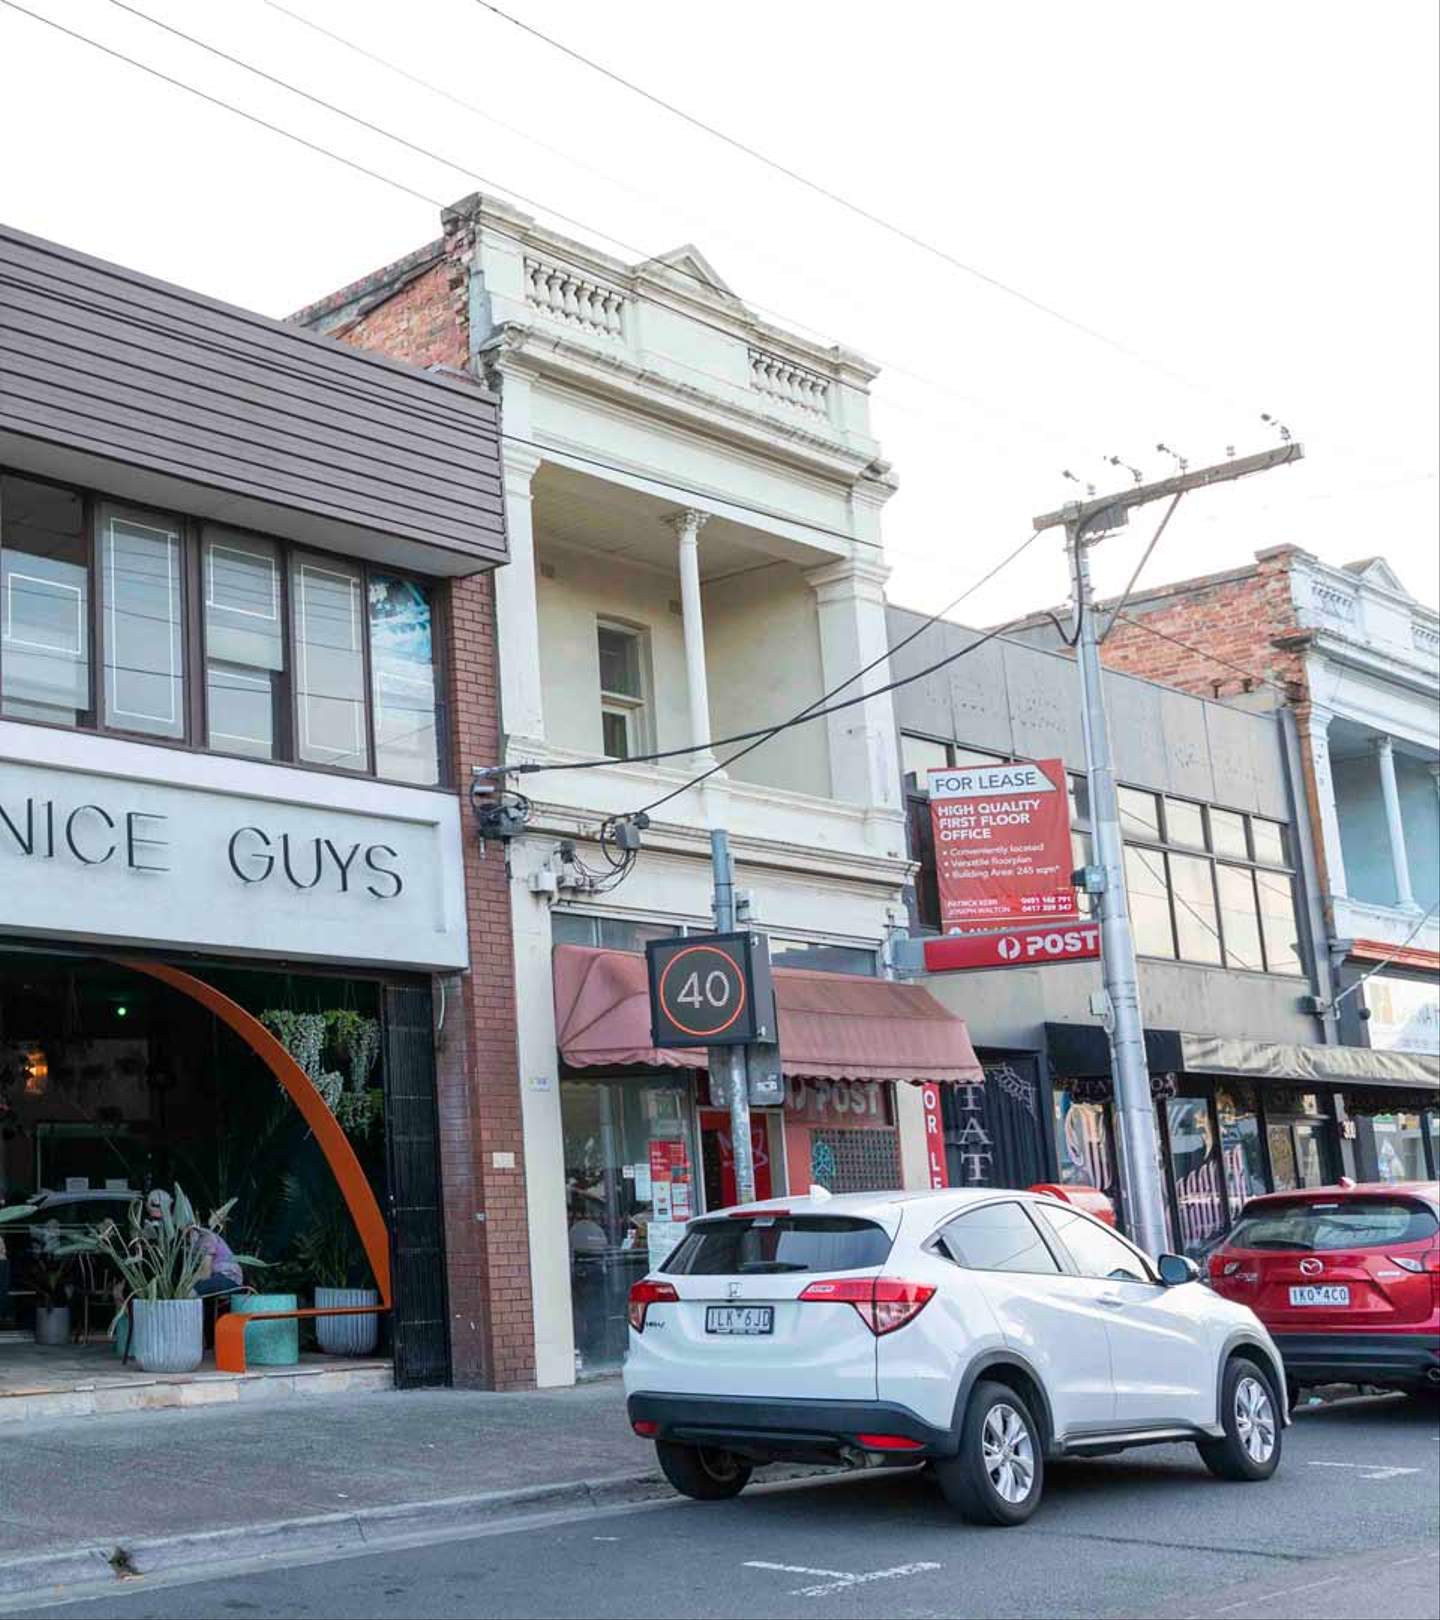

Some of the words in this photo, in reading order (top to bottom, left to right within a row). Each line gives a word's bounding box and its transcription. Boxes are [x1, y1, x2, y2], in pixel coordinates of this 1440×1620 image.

[935, 777, 973, 793] FOR
[979, 771, 1038, 790] LEASE
[938, 804, 975, 817] HIGH
[977, 799, 1041, 816] QUALITY
[938, 816, 976, 829] FIRST
[980, 813, 1031, 826] FLOOR
[940, 828, 992, 841] OFFICE
[949, 847, 1009, 857] Conveniently
[1009, 842, 1045, 852] located
[227, 826, 404, 899] GUYS
[950, 857, 990, 867] Versatile
[991, 855, 1033, 867] floorplan
[1025, 930, 1099, 956] POST
[676, 970, 730, 1009] 40
[815, 1080, 880, 1115] POST
